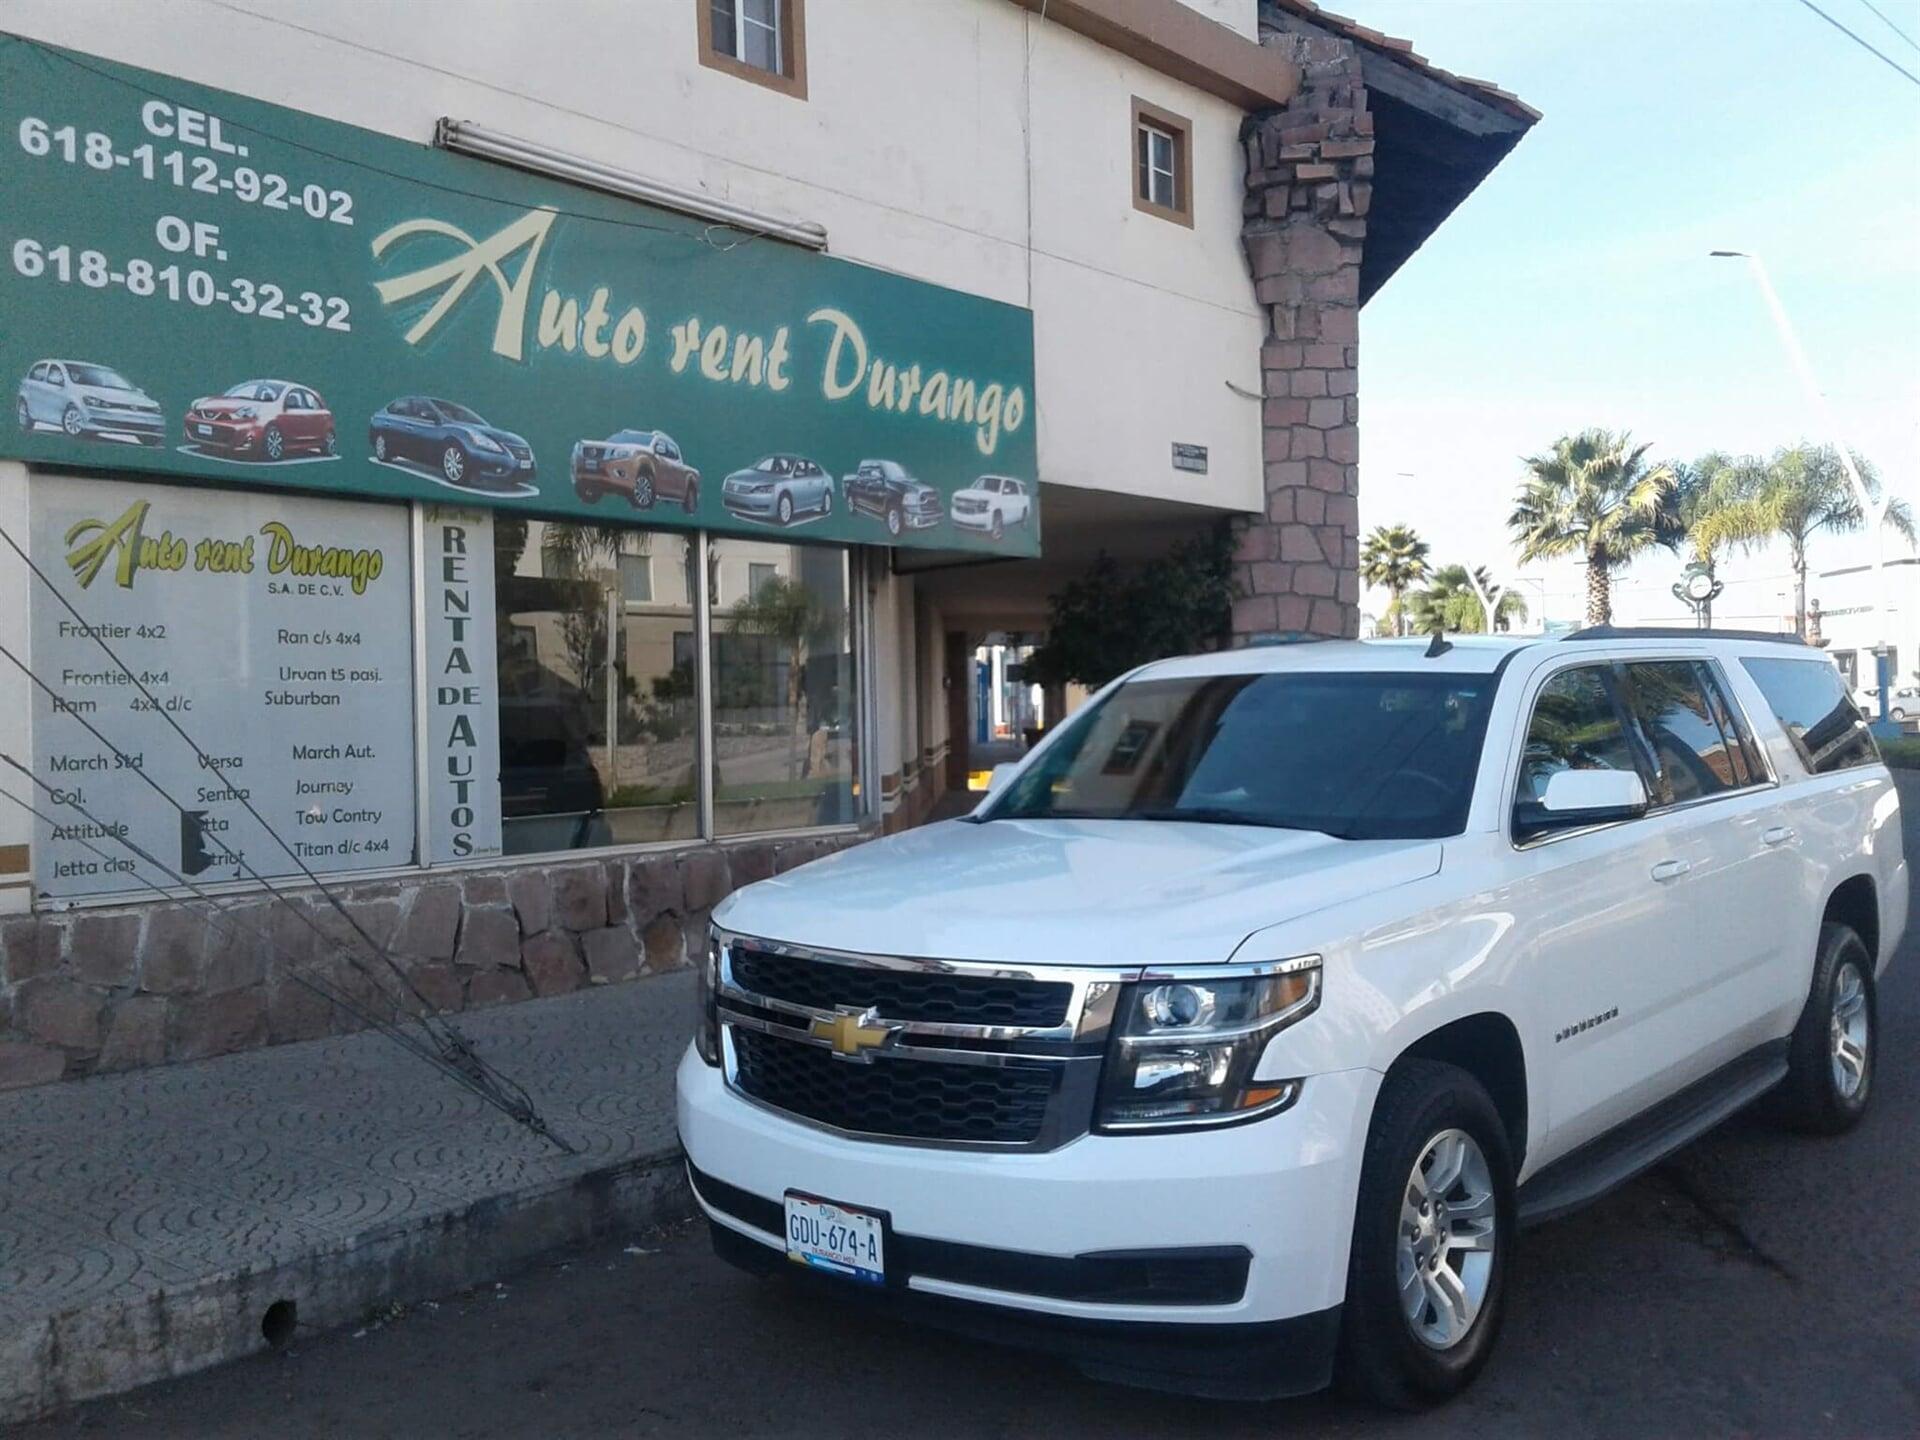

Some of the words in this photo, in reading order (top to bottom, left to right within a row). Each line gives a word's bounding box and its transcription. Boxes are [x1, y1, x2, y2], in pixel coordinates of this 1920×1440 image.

[141, 100, 249, 157] CEL.
[18, 117, 355, 226] 618-112-92-02
[155, 215, 229, 262] OF.
[12, 238, 352, 332] 618-810-32-32
[371, 205, 646, 362] Auto
[669, 317, 793, 390] rent
[807, 308, 1025, 456] Durango
[64, 500, 188, 590] Auto
[194, 535, 255, 574] rent
[260, 521, 383, 595] Durango
[298, 584, 317, 596] DE
[319, 584, 345, 597] C.V.
[58, 621, 132, 639] Frontier
[136, 624, 167, 639] 4x2
[277, 629, 309, 645] Ran
[313, 630, 333, 645] c/s
[335, 632, 362, 646] 4x4
[62, 669, 133, 686] Frontier
[139, 671, 169, 685] 4x4
[279, 667, 327, 681] Urvan
[52, 697, 97, 713] Ram
[129, 697, 160, 713] 4x4
[165, 695, 193, 713] d/c
[264, 690, 341, 706] Suburban
[437, 686, 482, 706] DE
[292, 744, 341, 760] March
[344, 743, 377, 759] Aut.
[50, 754, 108, 772] March
[114, 752, 144, 769] Std
[198, 753, 243, 770] Versa
[50, 788, 87, 805] Gol.
[197, 786, 251, 804] Sentra
[295, 779, 354, 796] Journey
[295, 809, 329, 826] Tow
[332, 807, 383, 825] Contry
[51, 821, 130, 842] Attitude
[294, 842, 335, 858] Titan
[337, 839, 362, 855] d/c
[363, 838, 390, 853] 4x4
[53, 860, 99, 878] Jetta
[790, 1213, 878, 1264] GDU-674-A
